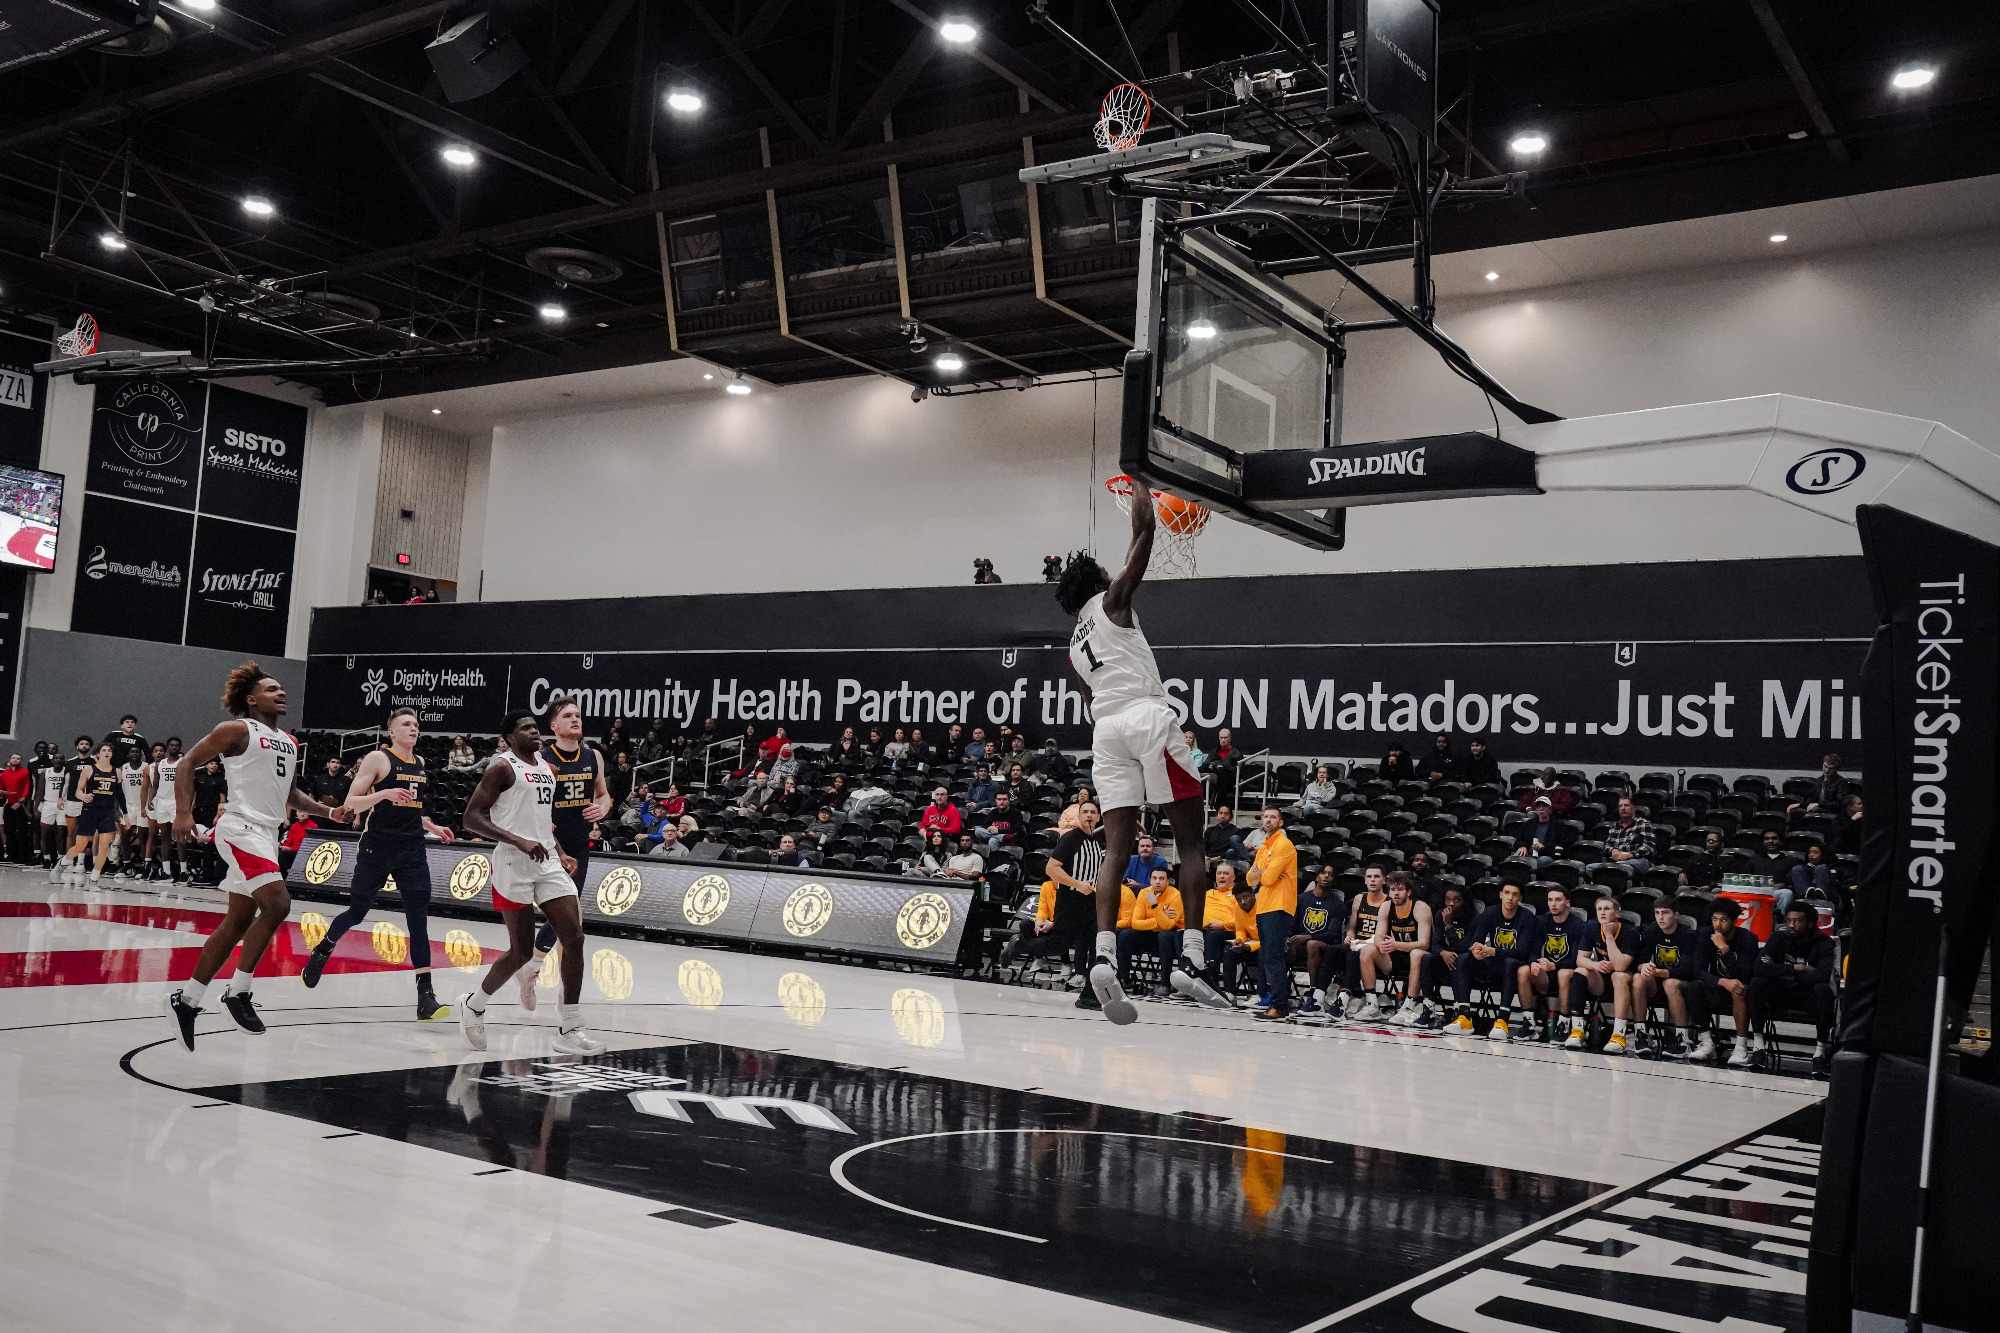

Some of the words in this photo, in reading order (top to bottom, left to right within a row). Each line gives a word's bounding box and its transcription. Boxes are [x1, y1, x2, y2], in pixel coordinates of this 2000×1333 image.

[116, 384, 184, 421] CALIFORNIA
[129, 446, 162, 461] PRINT
[224, 428, 286, 457] SISTO
[207, 445, 244, 466] Sports
[248, 453, 298, 477] Medicine
[1307, 446, 1427, 485] SPALDING
[101, 461, 135, 477] Printing
[146, 470, 188, 488] Embroidery
[123, 480, 165, 495] Chatsworth
[585, 656, 591, 667] 2
[1005, 652, 1014, 664] 3
[1080, 640, 1104, 672] 1
[1620, 647, 1630, 659] 4
[393, 668, 438, 691] Dignity
[391, 695, 431, 709] Northridge
[433, 695, 464, 709] Hospital
[711, 678, 821, 721] Health
[835, 678, 974, 725] Partner
[986, 677, 1027, 725] of
[1162, 678, 1269, 730] SUN
[419, 710, 444, 722] Center
[260, 737, 295, 755] CSUN
[276, 755, 286, 777] 5
[525, 772, 554, 785] CSUN
[536, 786, 551, 805] 13
[563, 781, 585, 799] 32
[602, 868, 640, 893] GOLD'S
[688, 876, 729, 901] GOLD'S
[788, 885, 832, 912] GOLD'S
[901, 895, 949, 922] GOLD'S
[1362, 919, 1376, 934] 22
